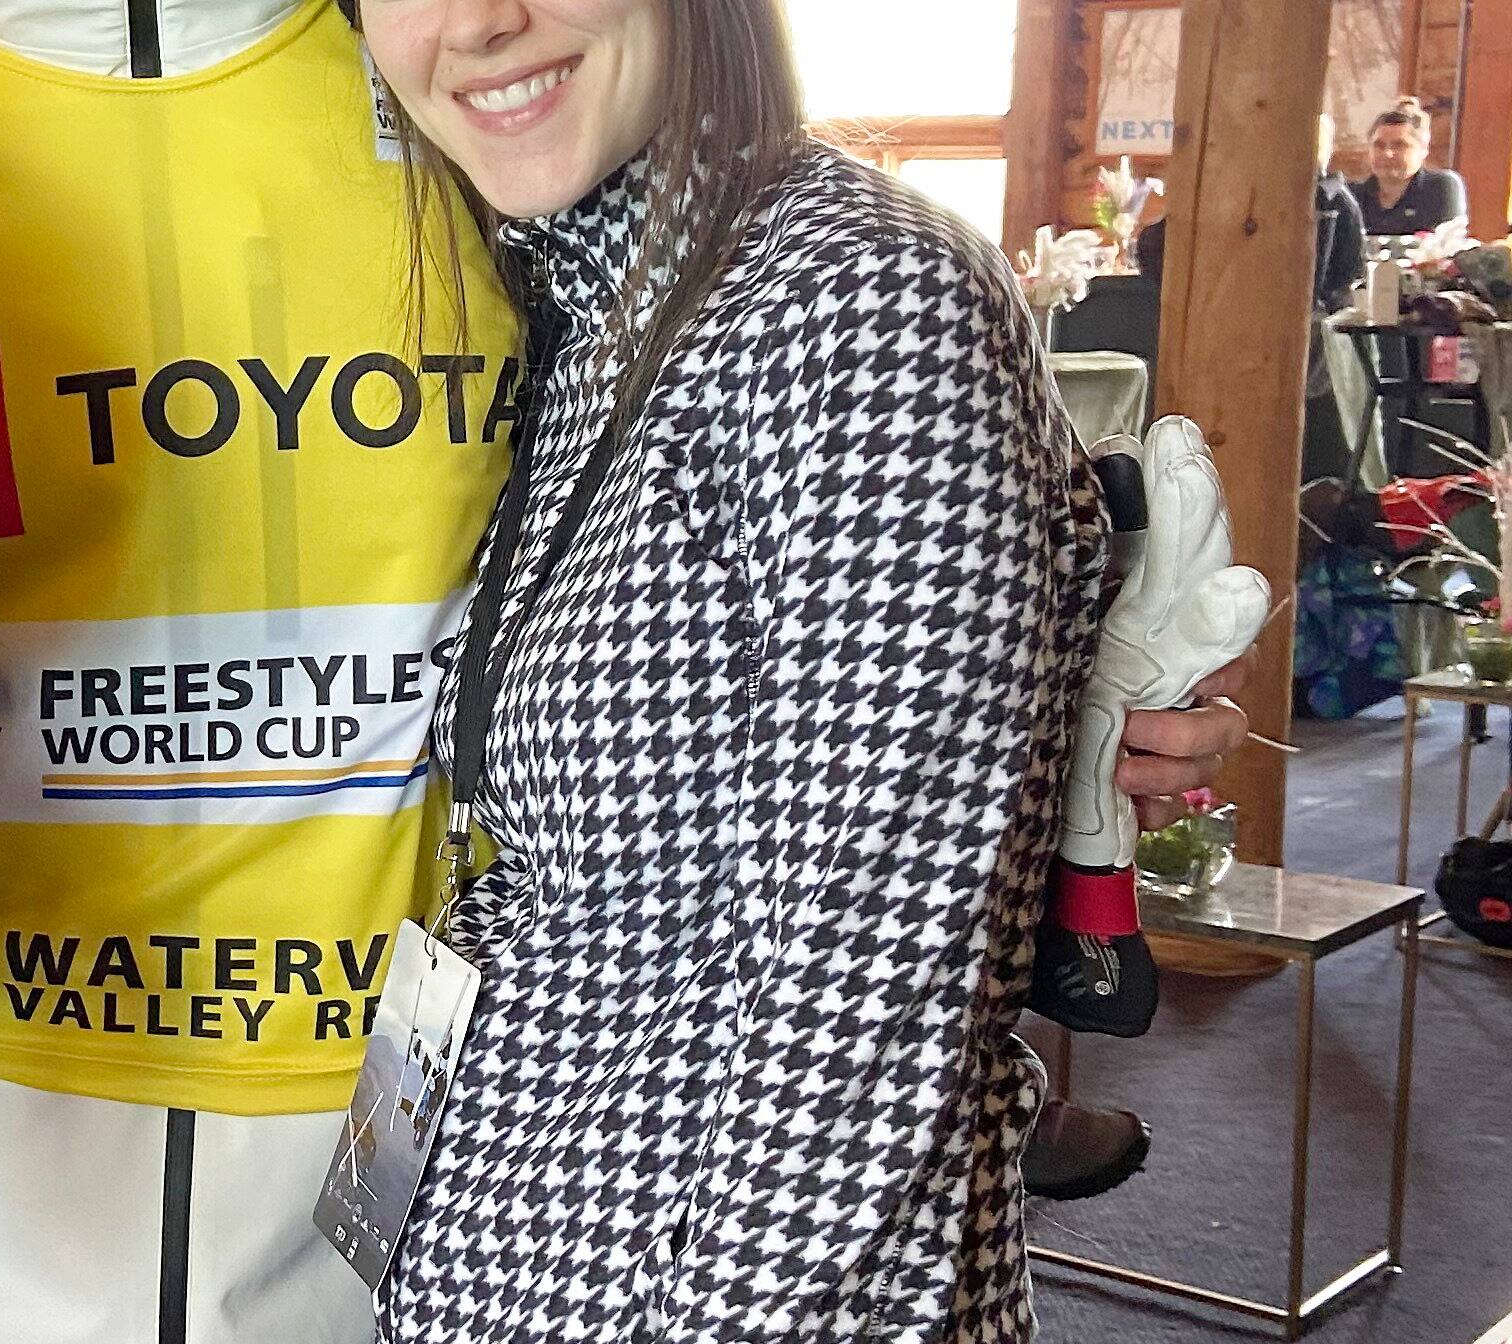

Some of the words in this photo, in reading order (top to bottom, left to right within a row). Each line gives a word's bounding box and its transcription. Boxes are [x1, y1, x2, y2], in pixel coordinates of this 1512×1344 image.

[1102, 120, 1172, 140] NEXT
[56, 353, 519, 465] TOYOTA
[42, 721, 242, 765] WORLD
[256, 716, 360, 759] CUP
[4, 931, 389, 996] WATERV
[3, 983, 275, 1041] VALLEY
